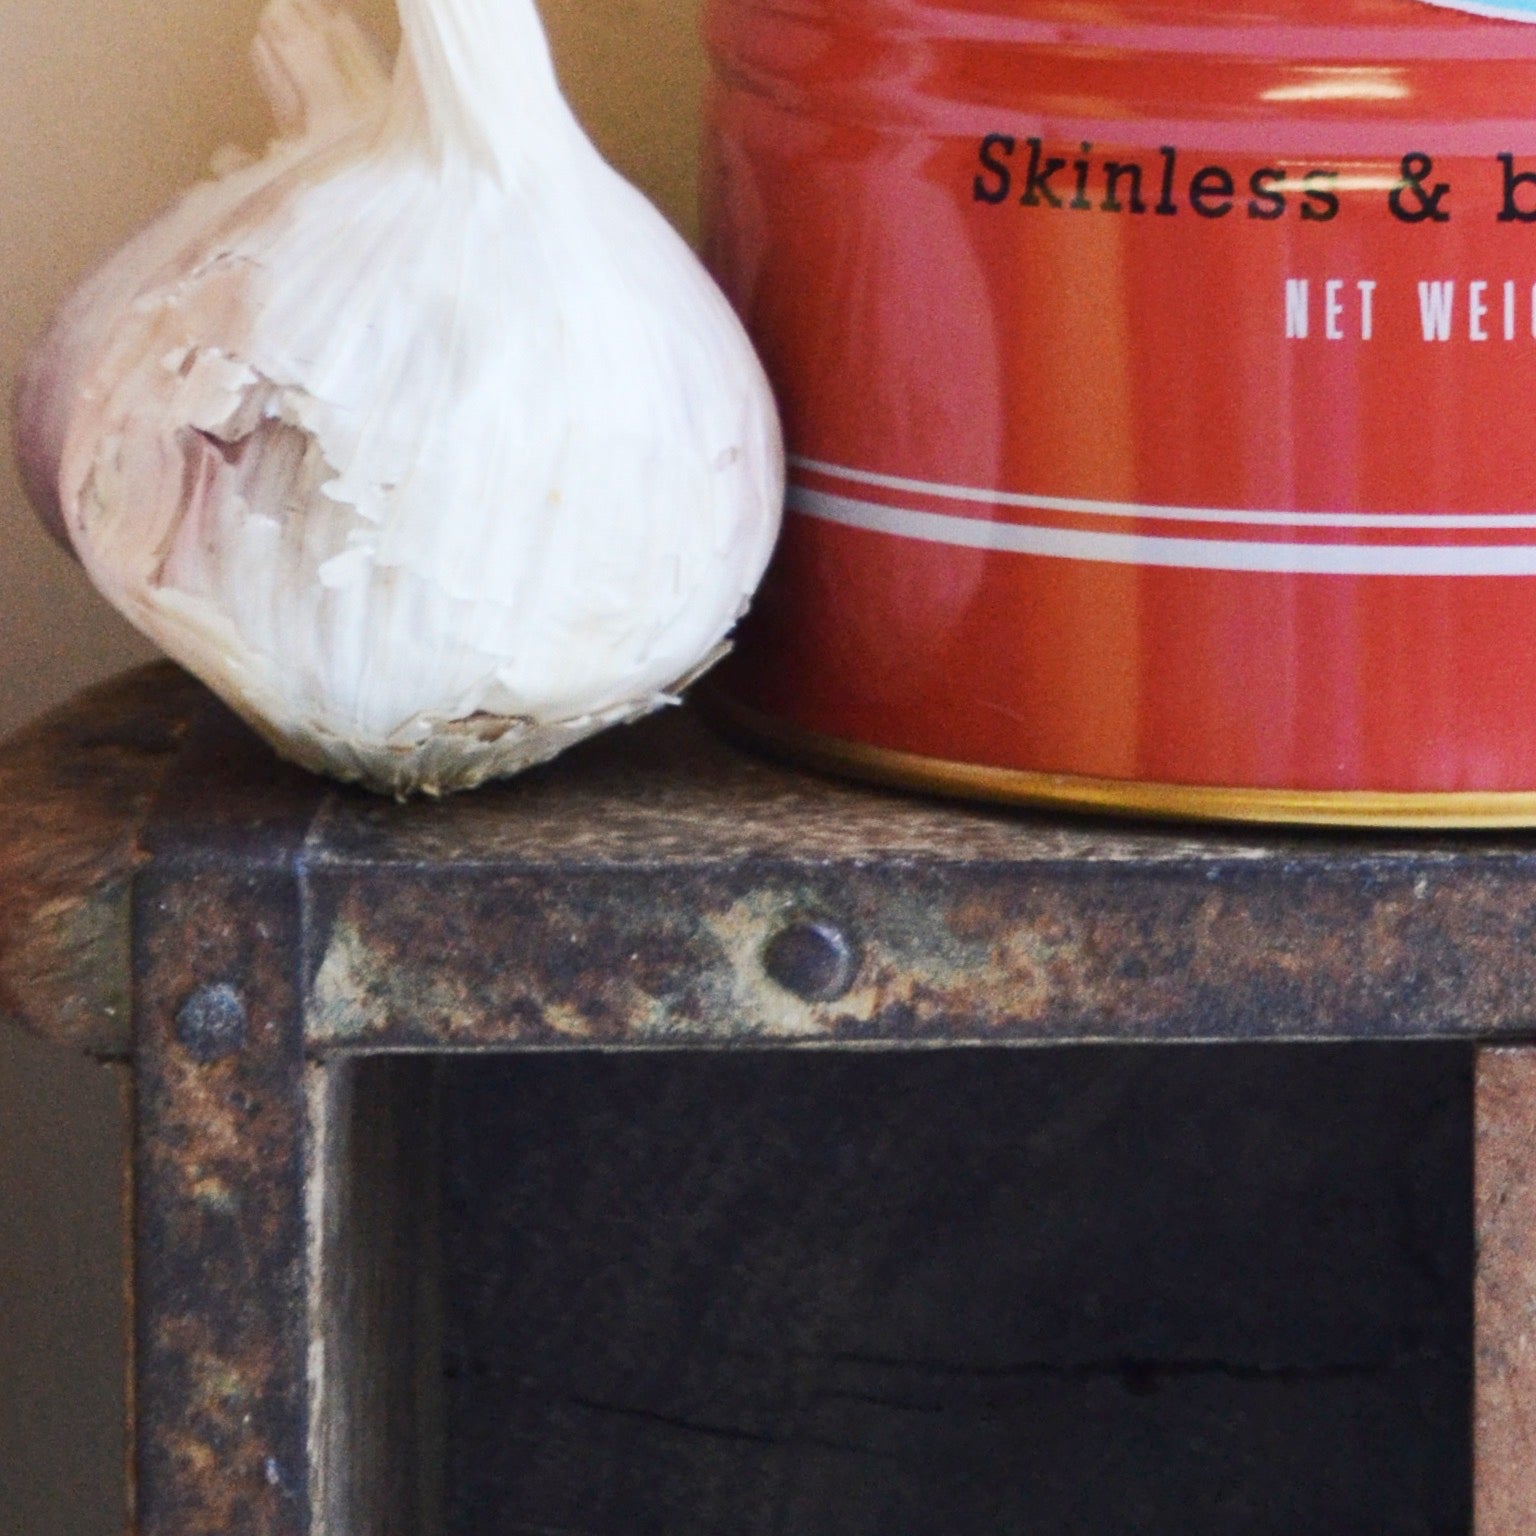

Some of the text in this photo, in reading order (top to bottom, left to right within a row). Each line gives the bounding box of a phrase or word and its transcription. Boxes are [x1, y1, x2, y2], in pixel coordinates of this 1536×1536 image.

[973, 132, 1340, 222] Skinless
[1388, 152, 1450, 224] &
[1285, 278, 1376, 340] NET
